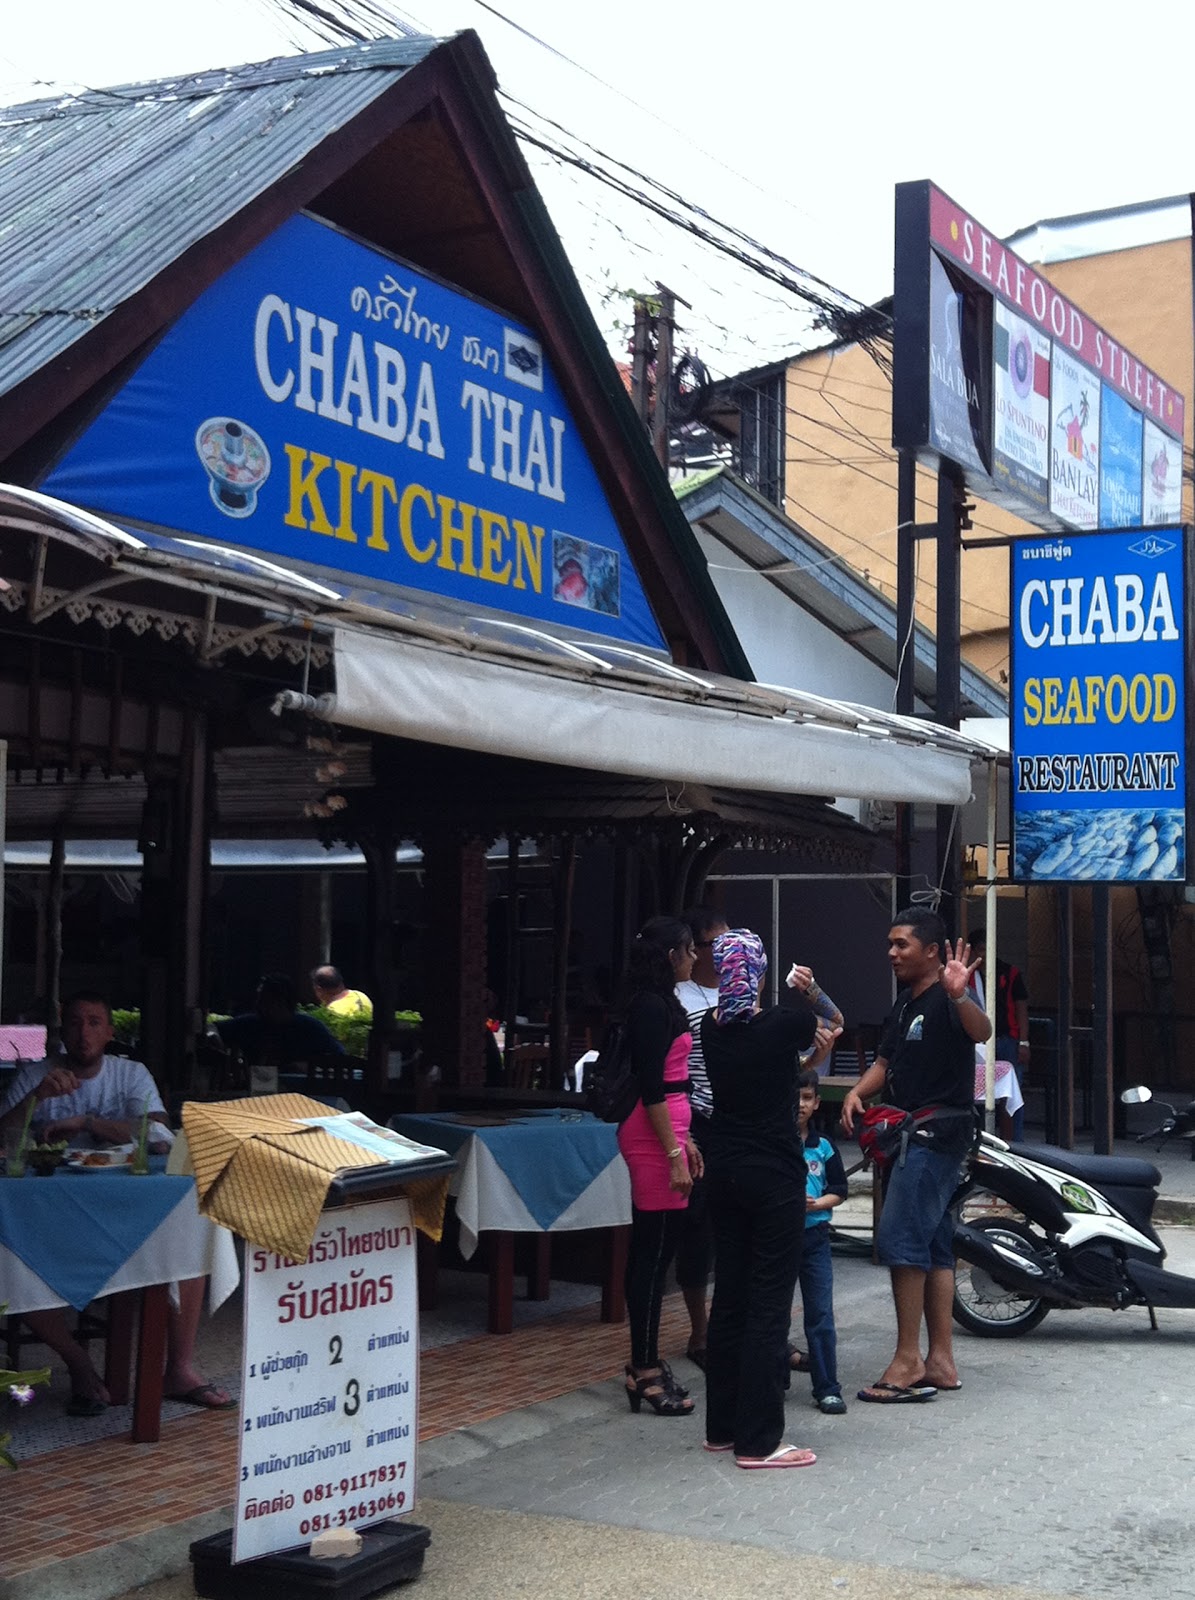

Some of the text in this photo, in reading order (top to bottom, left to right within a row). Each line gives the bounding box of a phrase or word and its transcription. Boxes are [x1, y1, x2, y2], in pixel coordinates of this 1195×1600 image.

[962, 218, 1168, 419] SEAFOOD STREET
[254, 294, 566, 503] CHABA THAI
[284, 443, 545, 594] KITCHEN
[1019, 572, 1179, 649] CHABA
[1023, 673, 1177, 727] SEAFOOD
[1017, 751, 1180, 793] RESTAURANT
[278, 1268, 393, 1324] รับสมัคร
[249, 1363, 257, 1378] 1
[328, 1334, 343, 1366] 2
[244, 1418, 252, 1433] 2
[343, 1378, 361, 1417] 3
[241, 1466, 249, 1482] 3
[243, 1461, 408, 1521] ติดต่อ 081-9117837
[300, 1491, 406, 1536] 081-3263069
